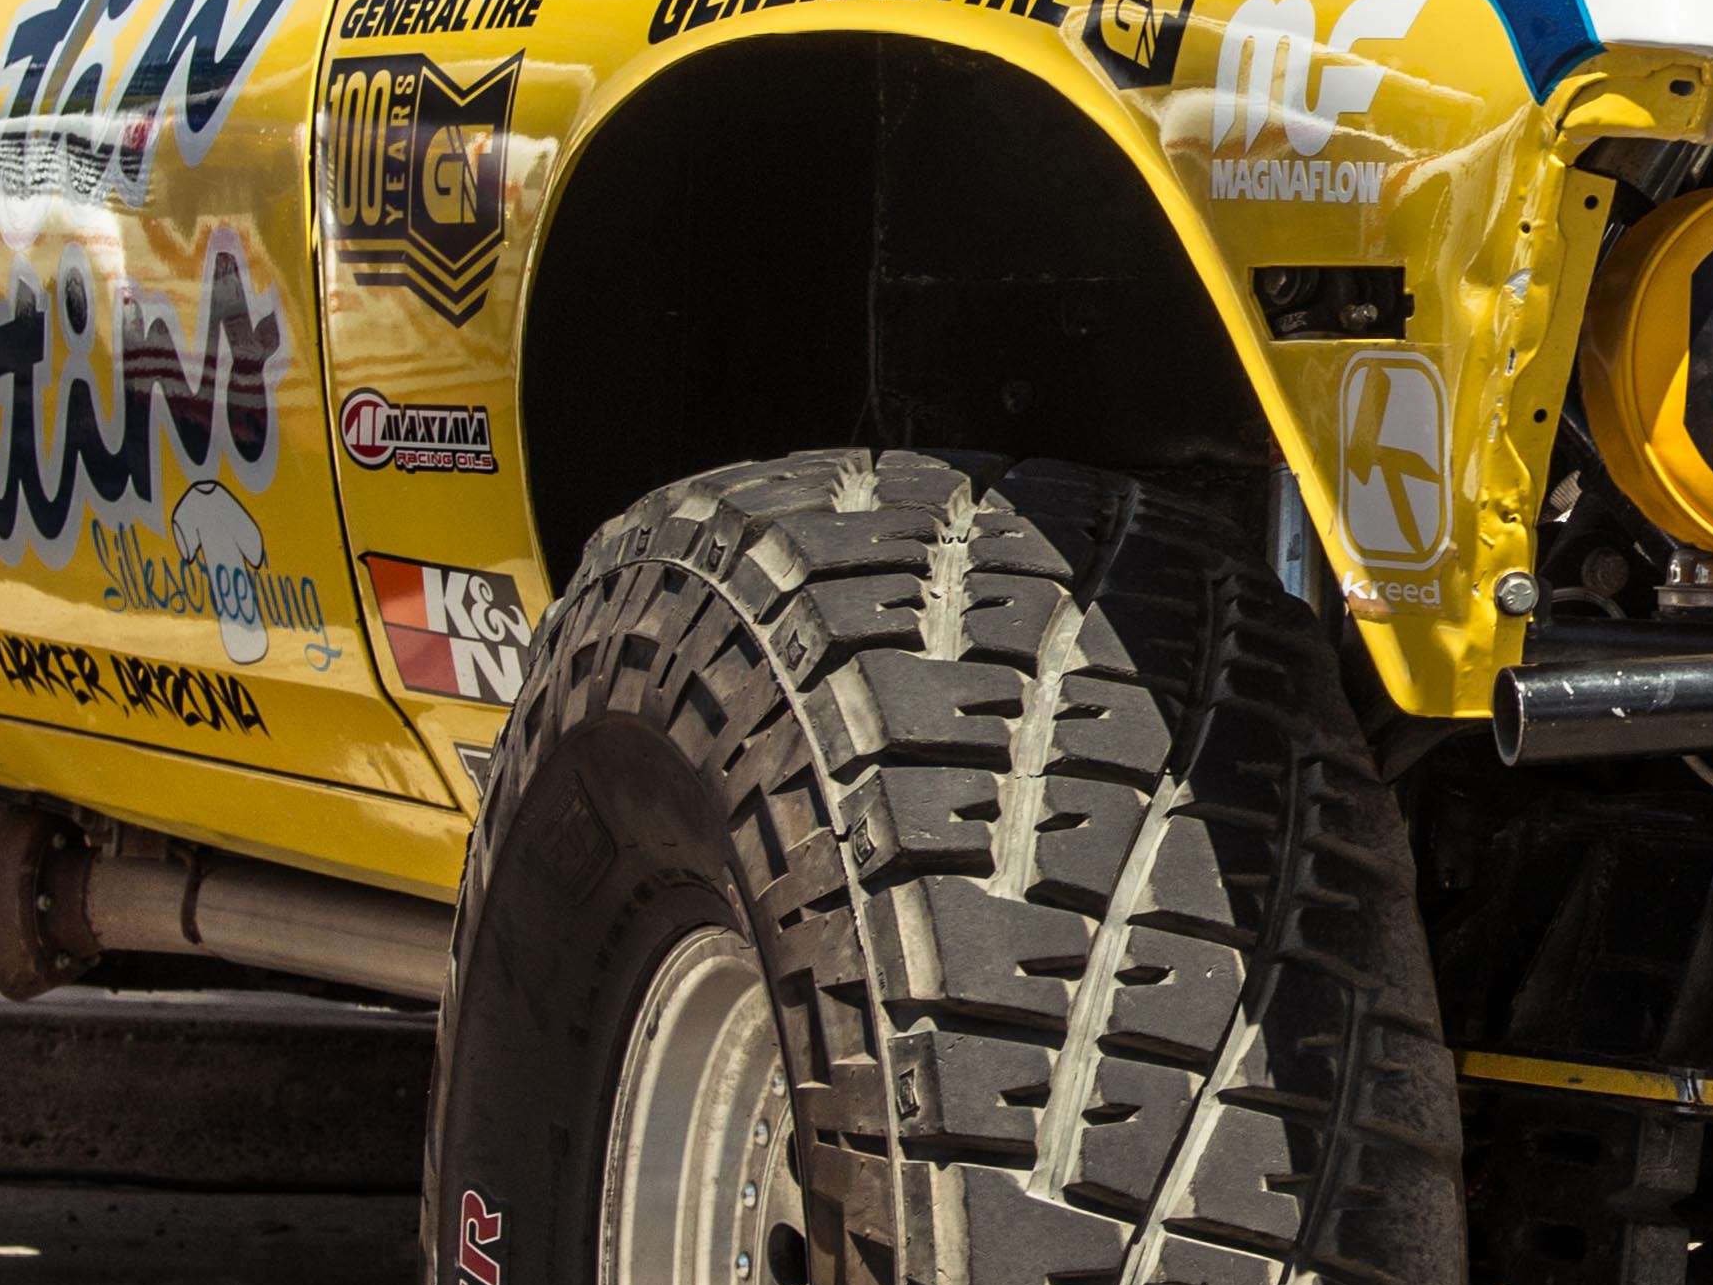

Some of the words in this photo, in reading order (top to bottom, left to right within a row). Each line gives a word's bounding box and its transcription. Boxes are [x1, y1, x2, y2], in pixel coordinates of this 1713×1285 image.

[330, 68, 393, 227] 100
[385, 72, 416, 226] YEARS
[1211, 159, 1386, 205] MAGNAFLOW
[380, 410, 489, 446] MAXIMA
[395, 450, 454, 468] RACING
[455, 452, 495, 470] OILS
[1342, 570, 1442, 605] kreed
